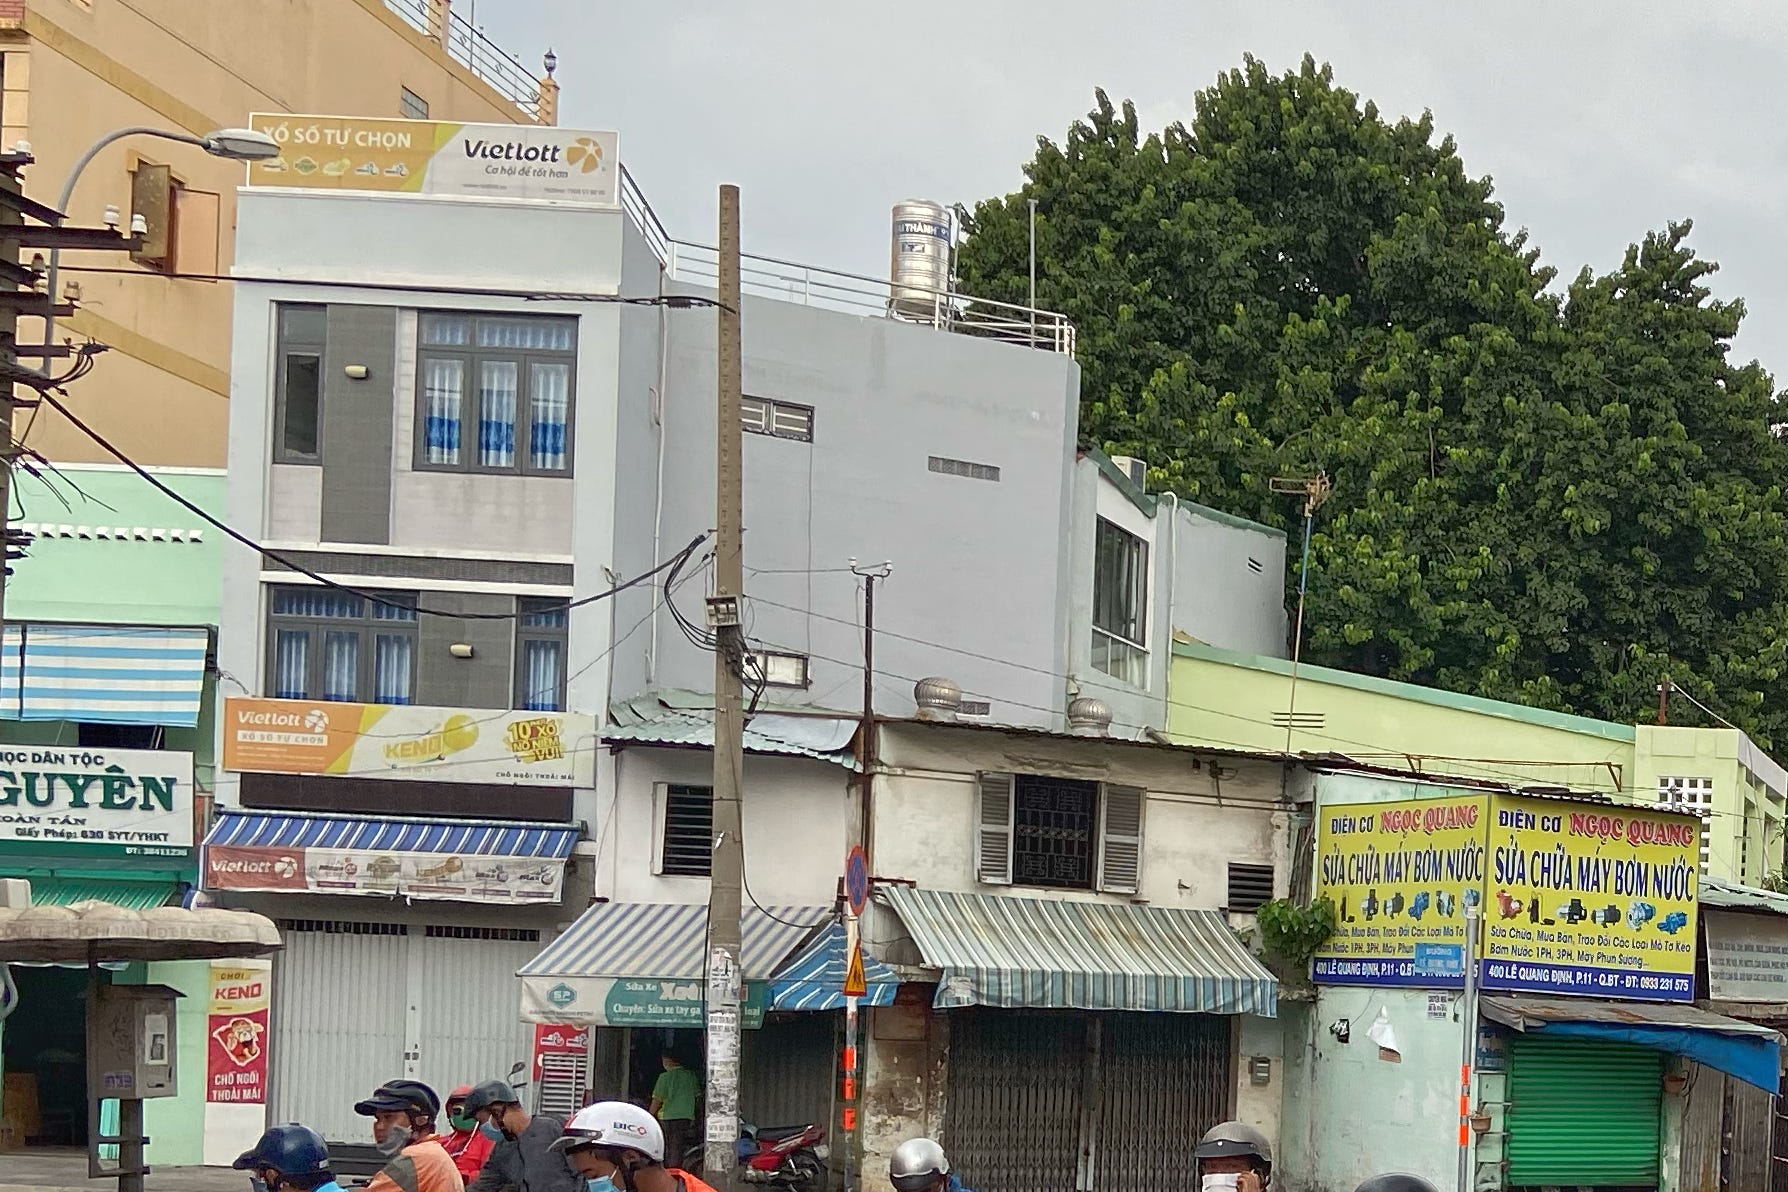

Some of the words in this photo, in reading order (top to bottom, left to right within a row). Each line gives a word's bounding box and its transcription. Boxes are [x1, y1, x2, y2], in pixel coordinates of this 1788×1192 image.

[294, 124, 321, 145] SỐ
[324, 127, 352, 150] TỰ
[355, 131, 411, 152] CHỌN
[464, 139, 561, 163] Vietlott
[238, 710, 301, 727] Vietlott
[32, 752, 65, 765] DÂN
[1379, 809, 1422, 838] NGỌC
[1423, 804, 1479, 835] QUANG
[1499, 809, 1535, 832] ĐIỆN
[1541, 815, 1562, 833] CƠ
[1569, 812, 1624, 844] NGỌC
[1626, 819, 1695, 848] QUANG
[211, 860, 272, 873] Vietlott
[1322, 843, 1345, 887] SỬA
[1348, 844, 1381, 886] CHỮA
[1384, 841, 1412, 885] MÁY
[1414, 843, 1443, 883] BƠM
[1446, 837, 1484, 882] NƯỚC
[1494, 835, 1526, 886] SỬA
[1530, 843, 1573, 891] CHỮA
[1576, 846, 1612, 894] MÁY
[1614, 854, 1649, 898] BƠM
[1652, 854, 1695, 902] NƯỚC
[1536, 929, 1555, 942] Mua
[1505, 963, 1517, 980] LÊ
[1519, 967, 1550, 982] QUANG
[1660, 977, 1673, 991] 231
[1675, 978, 1690, 992] 575
[214, 983, 262, 1000] KENO
[553, 990, 571, 999] SP
